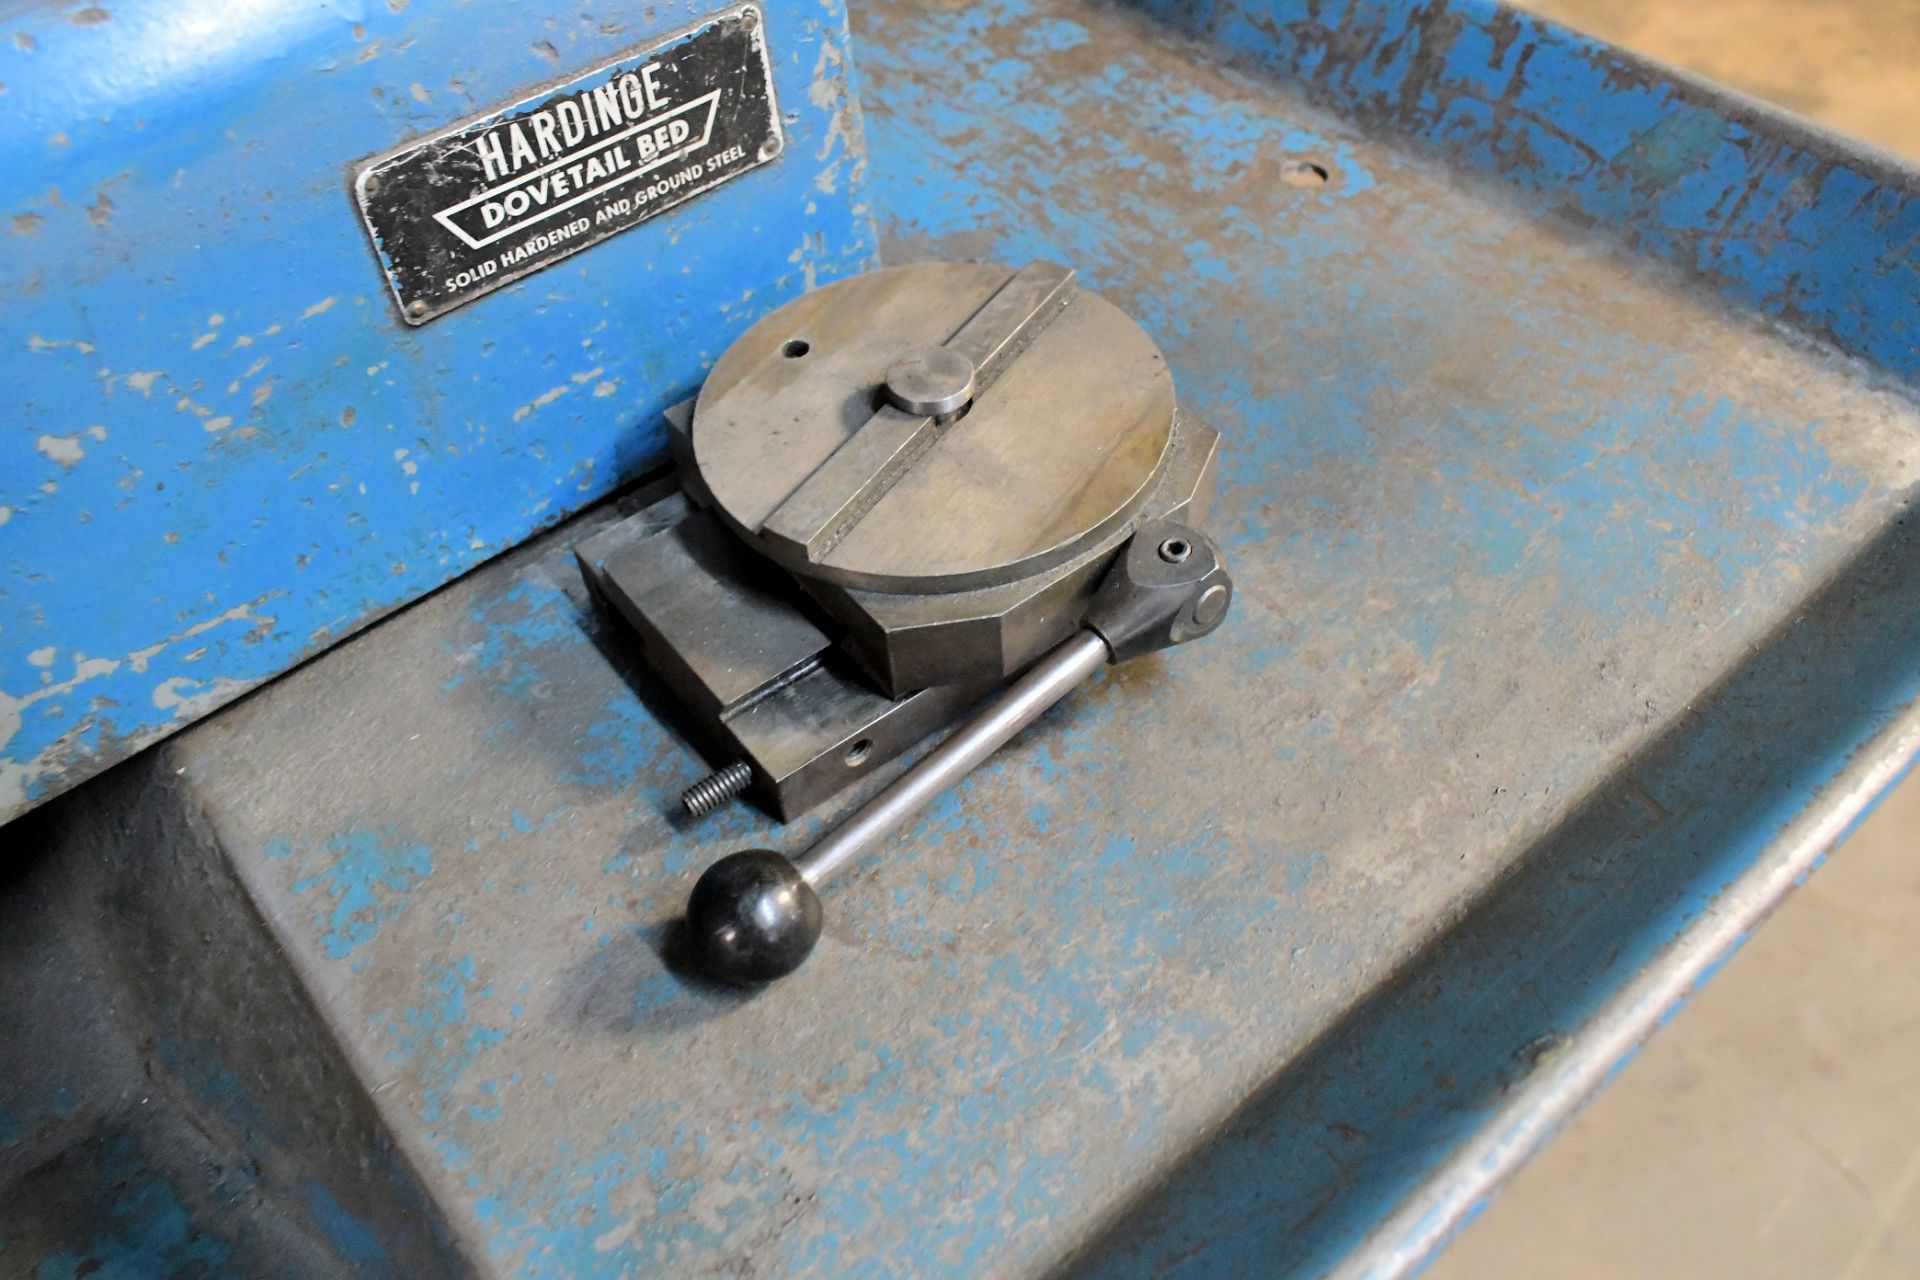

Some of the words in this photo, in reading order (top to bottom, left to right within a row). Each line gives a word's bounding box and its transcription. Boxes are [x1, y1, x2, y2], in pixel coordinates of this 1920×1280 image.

[476, 62, 671, 181] HARDINGE
[481, 154, 631, 229] DOVETAIL
[637, 119, 690, 158] BED
[445, 260, 497, 292] SOLID
[501, 218, 590, 267] HARDENED
[595, 199, 630, 225] AND
[635, 165, 703, 205] GROUND
[706, 144, 746, 172] STEEL
